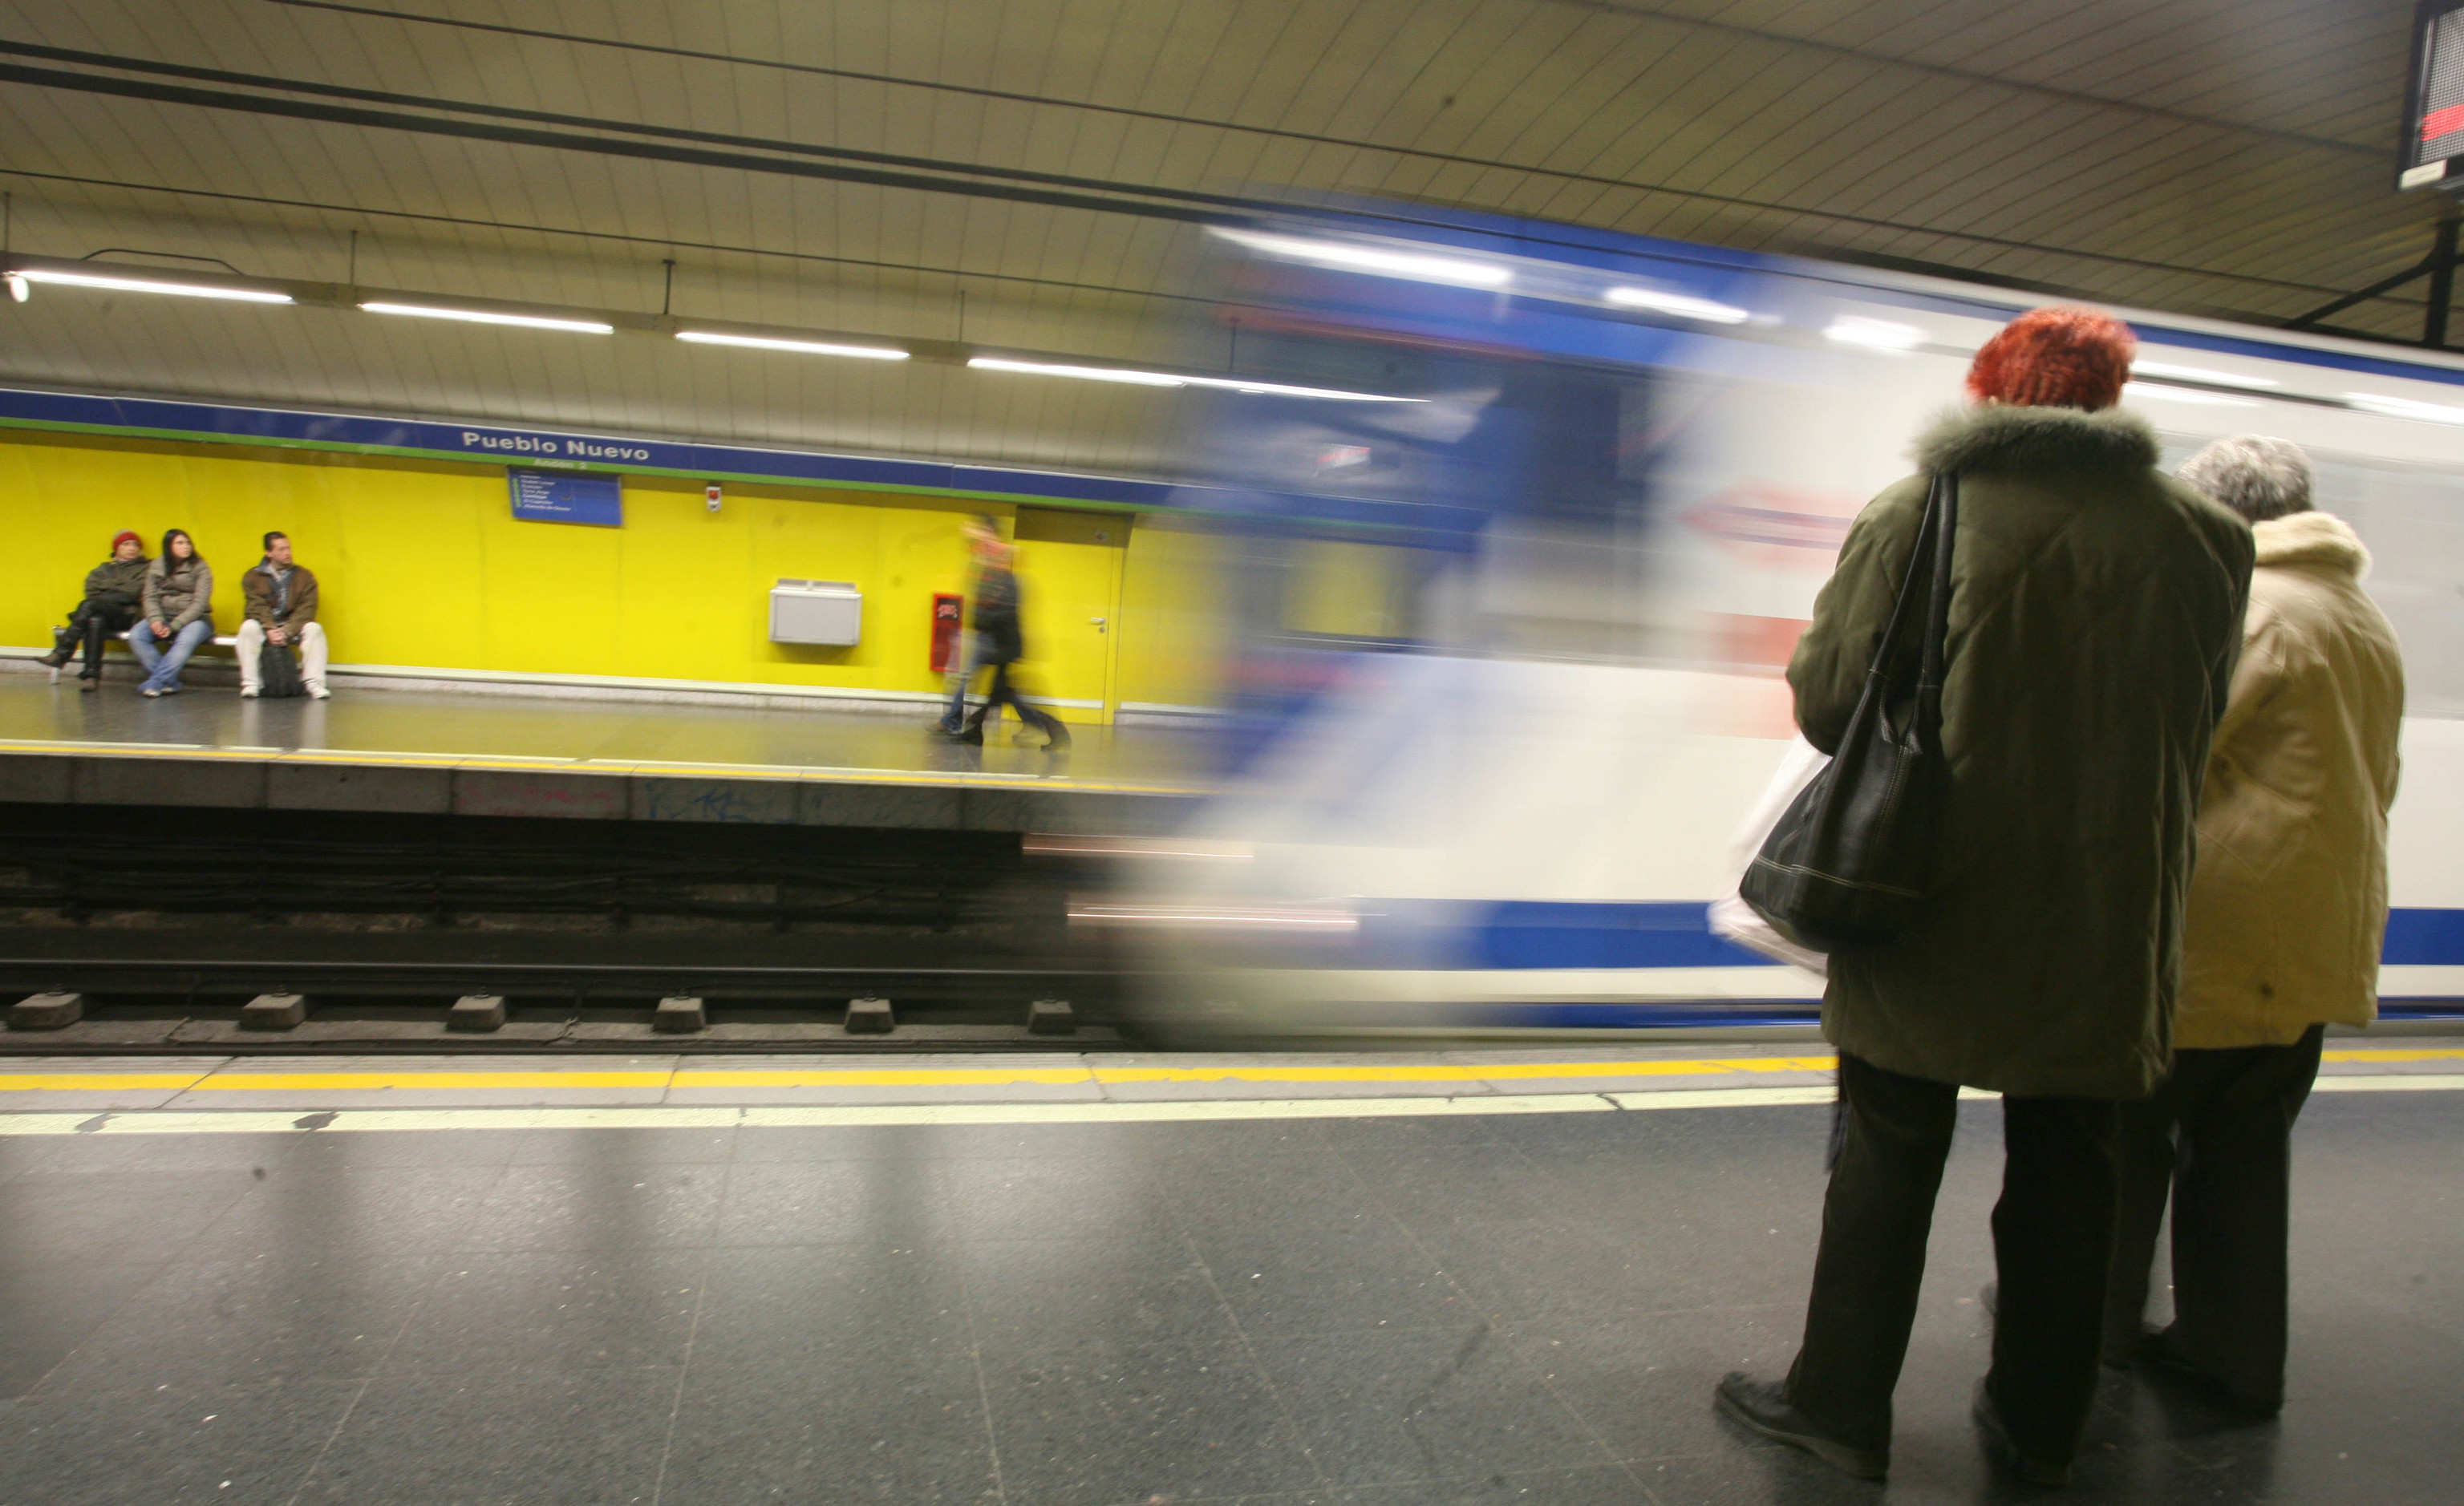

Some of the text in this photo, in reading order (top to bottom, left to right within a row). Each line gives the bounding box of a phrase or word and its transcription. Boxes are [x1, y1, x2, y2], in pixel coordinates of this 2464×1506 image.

[462, 431, 650, 461] Pueblo Nuevo
[579, 462, 588, 470] 2
